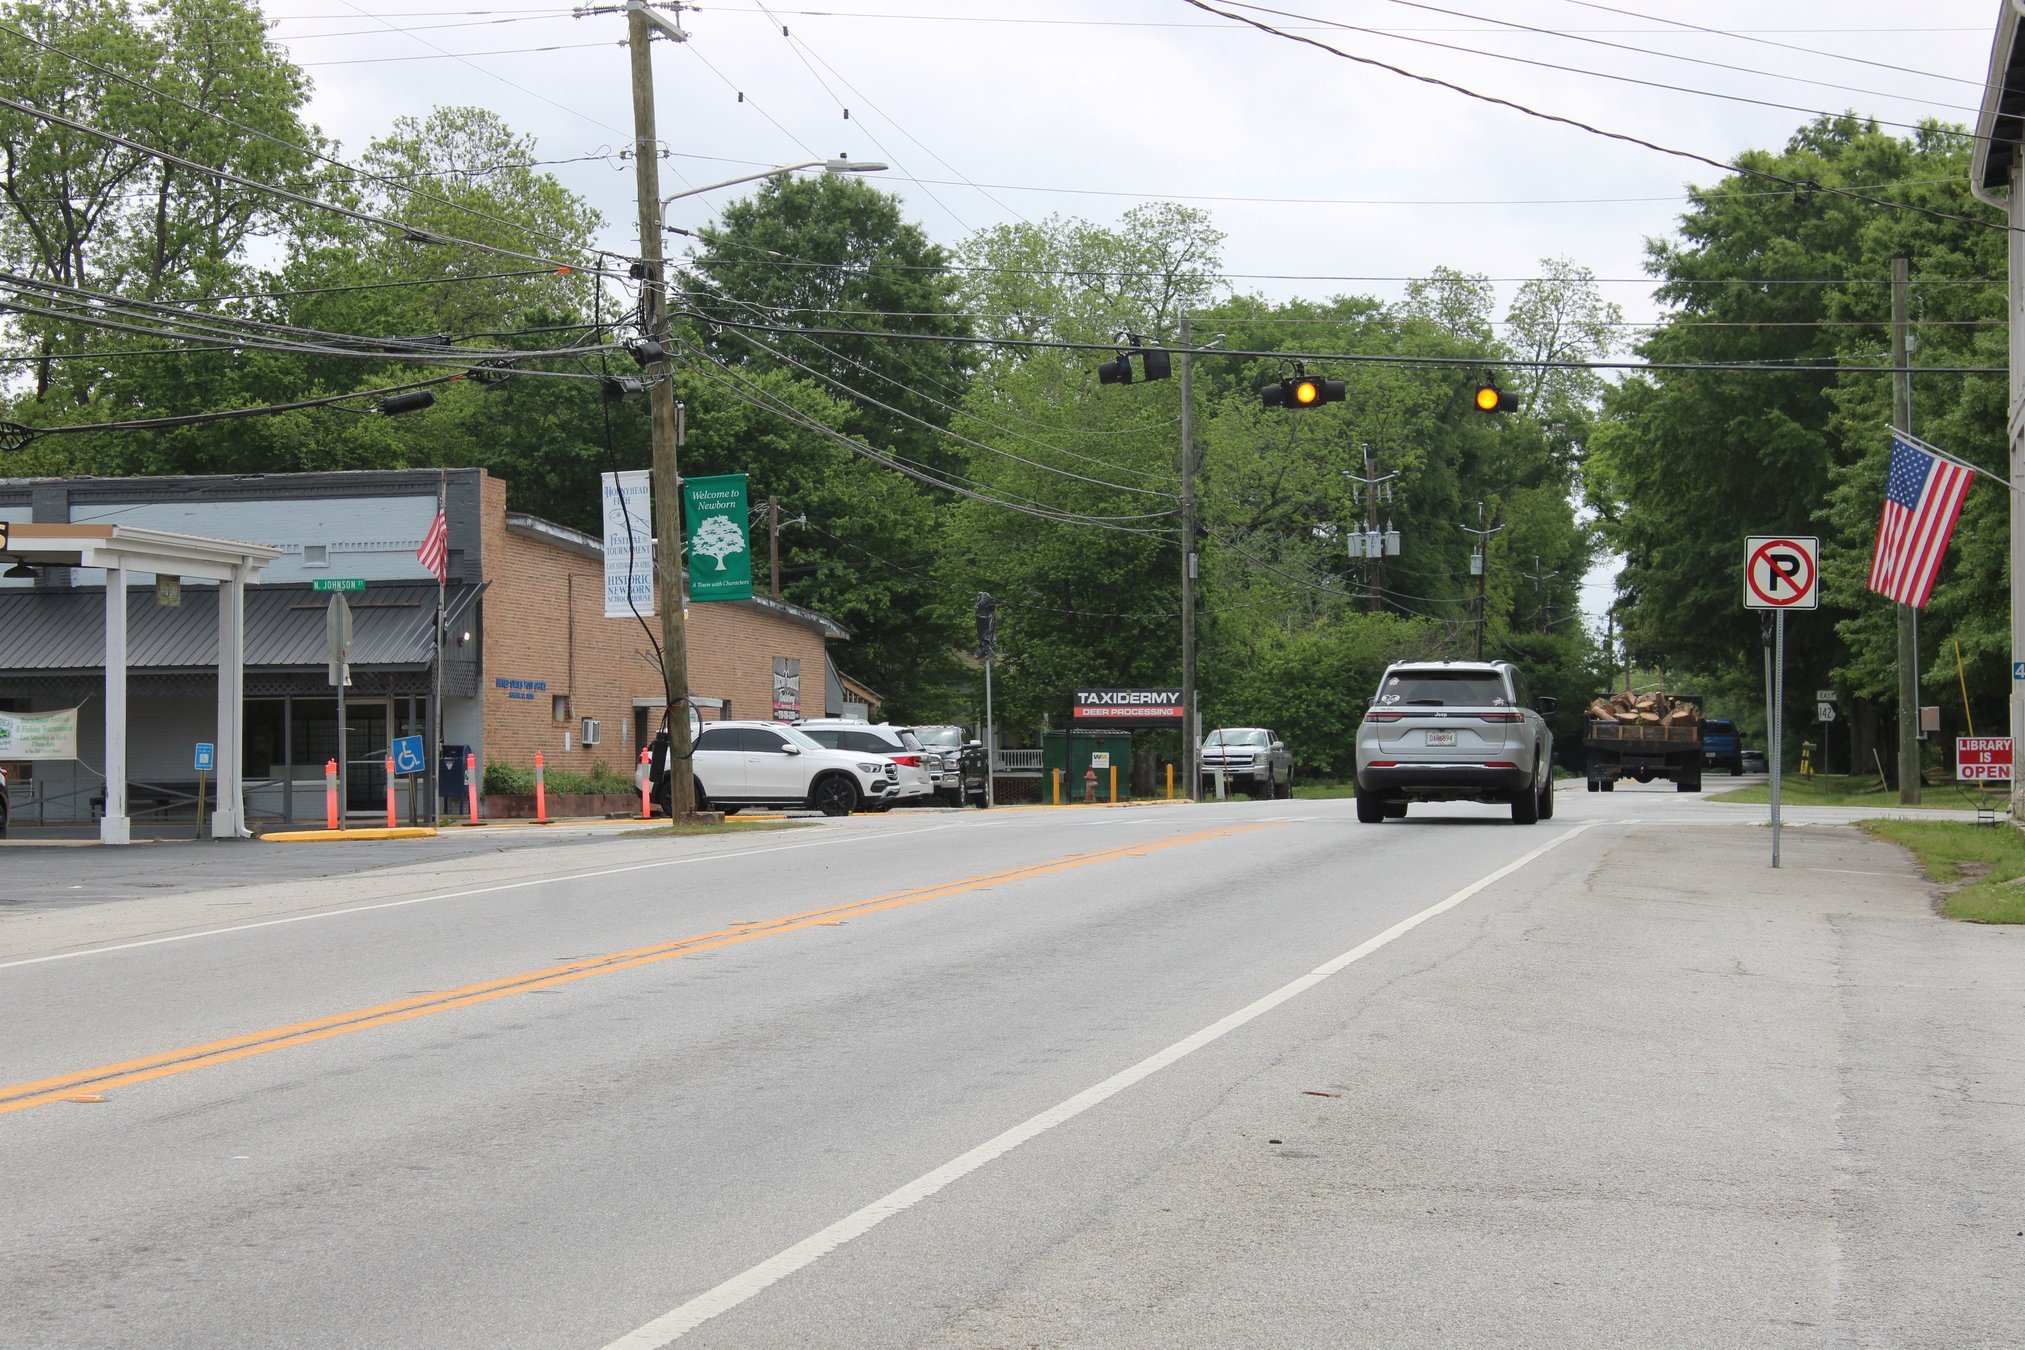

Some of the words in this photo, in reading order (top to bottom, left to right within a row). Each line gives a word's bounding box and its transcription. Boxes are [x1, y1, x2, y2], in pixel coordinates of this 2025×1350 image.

[604, 486, 648, 498] HONYHEAD
[692, 490, 730, 500] Welcome
[731, 490, 740, 498] to
[613, 497, 631, 505] FIH
[697, 500, 736, 510] Newborn
[610, 533, 642, 546] FESTIAL
[607, 546, 650, 556] TOURNMENT
[322, 580, 356, 590] JOHNSON
[608, 584, 651, 595] NEWORN
[1078, 692, 1180, 704] TAXIDERMY
[1083, 708, 1109, 716] DEER
[1111, 708, 1174, 716] PROCESSING
[1819, 707, 1832, 719] 142
[1959, 740, 2011, 751] LIBRARY
[1980, 752, 1992, 763] IS
[1961, 766, 2011, 779] OPEN
